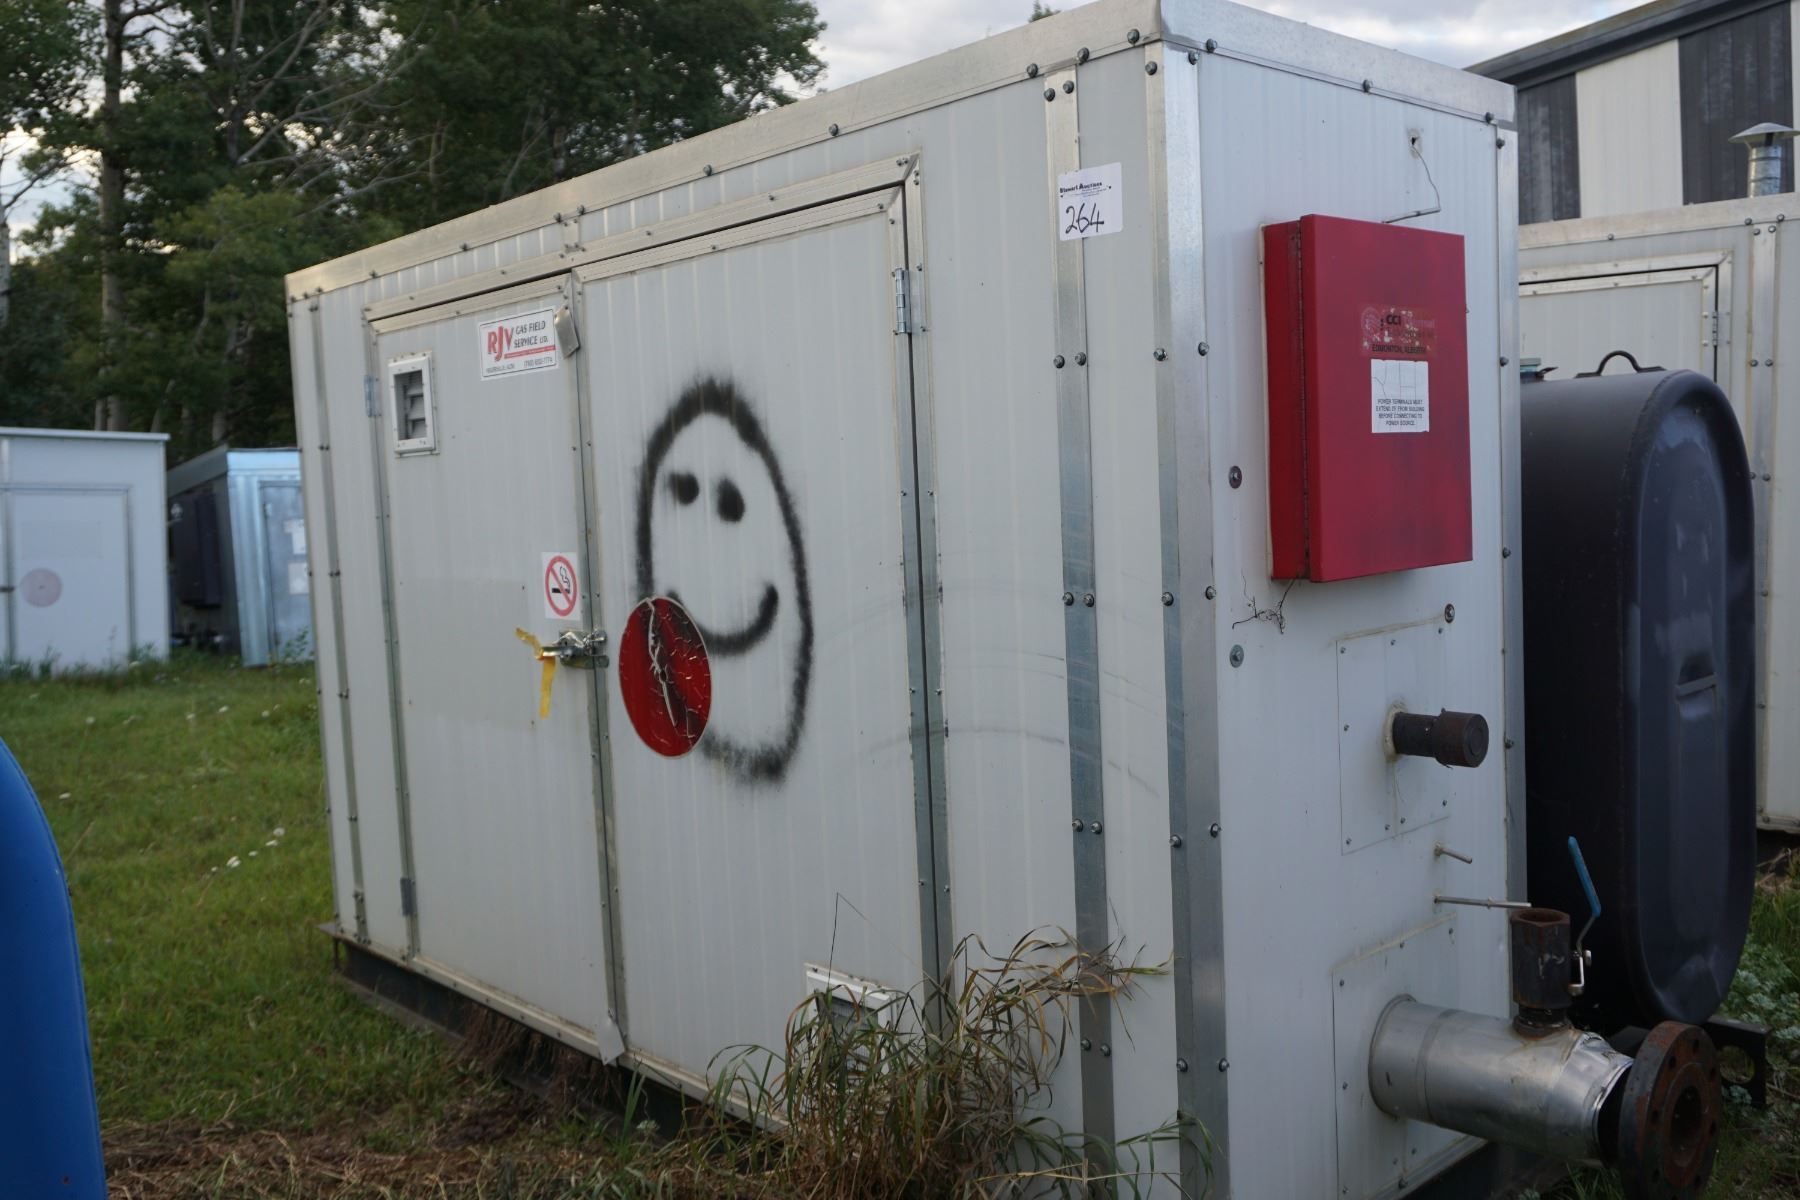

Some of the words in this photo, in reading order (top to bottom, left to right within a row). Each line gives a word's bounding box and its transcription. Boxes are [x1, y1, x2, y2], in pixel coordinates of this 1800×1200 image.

[1060, 185, 1078, 193] Stewart
[1079, 182, 1102, 190] Auctions
[1065, 203, 1104, 234] 264
[1386, 314, 1401, 325] CCI
[515, 325, 527, 335] GAS
[528, 320, 546, 333] FIELD
[487, 325, 514, 362] RJV
[513, 335, 538, 348] SERVICE
